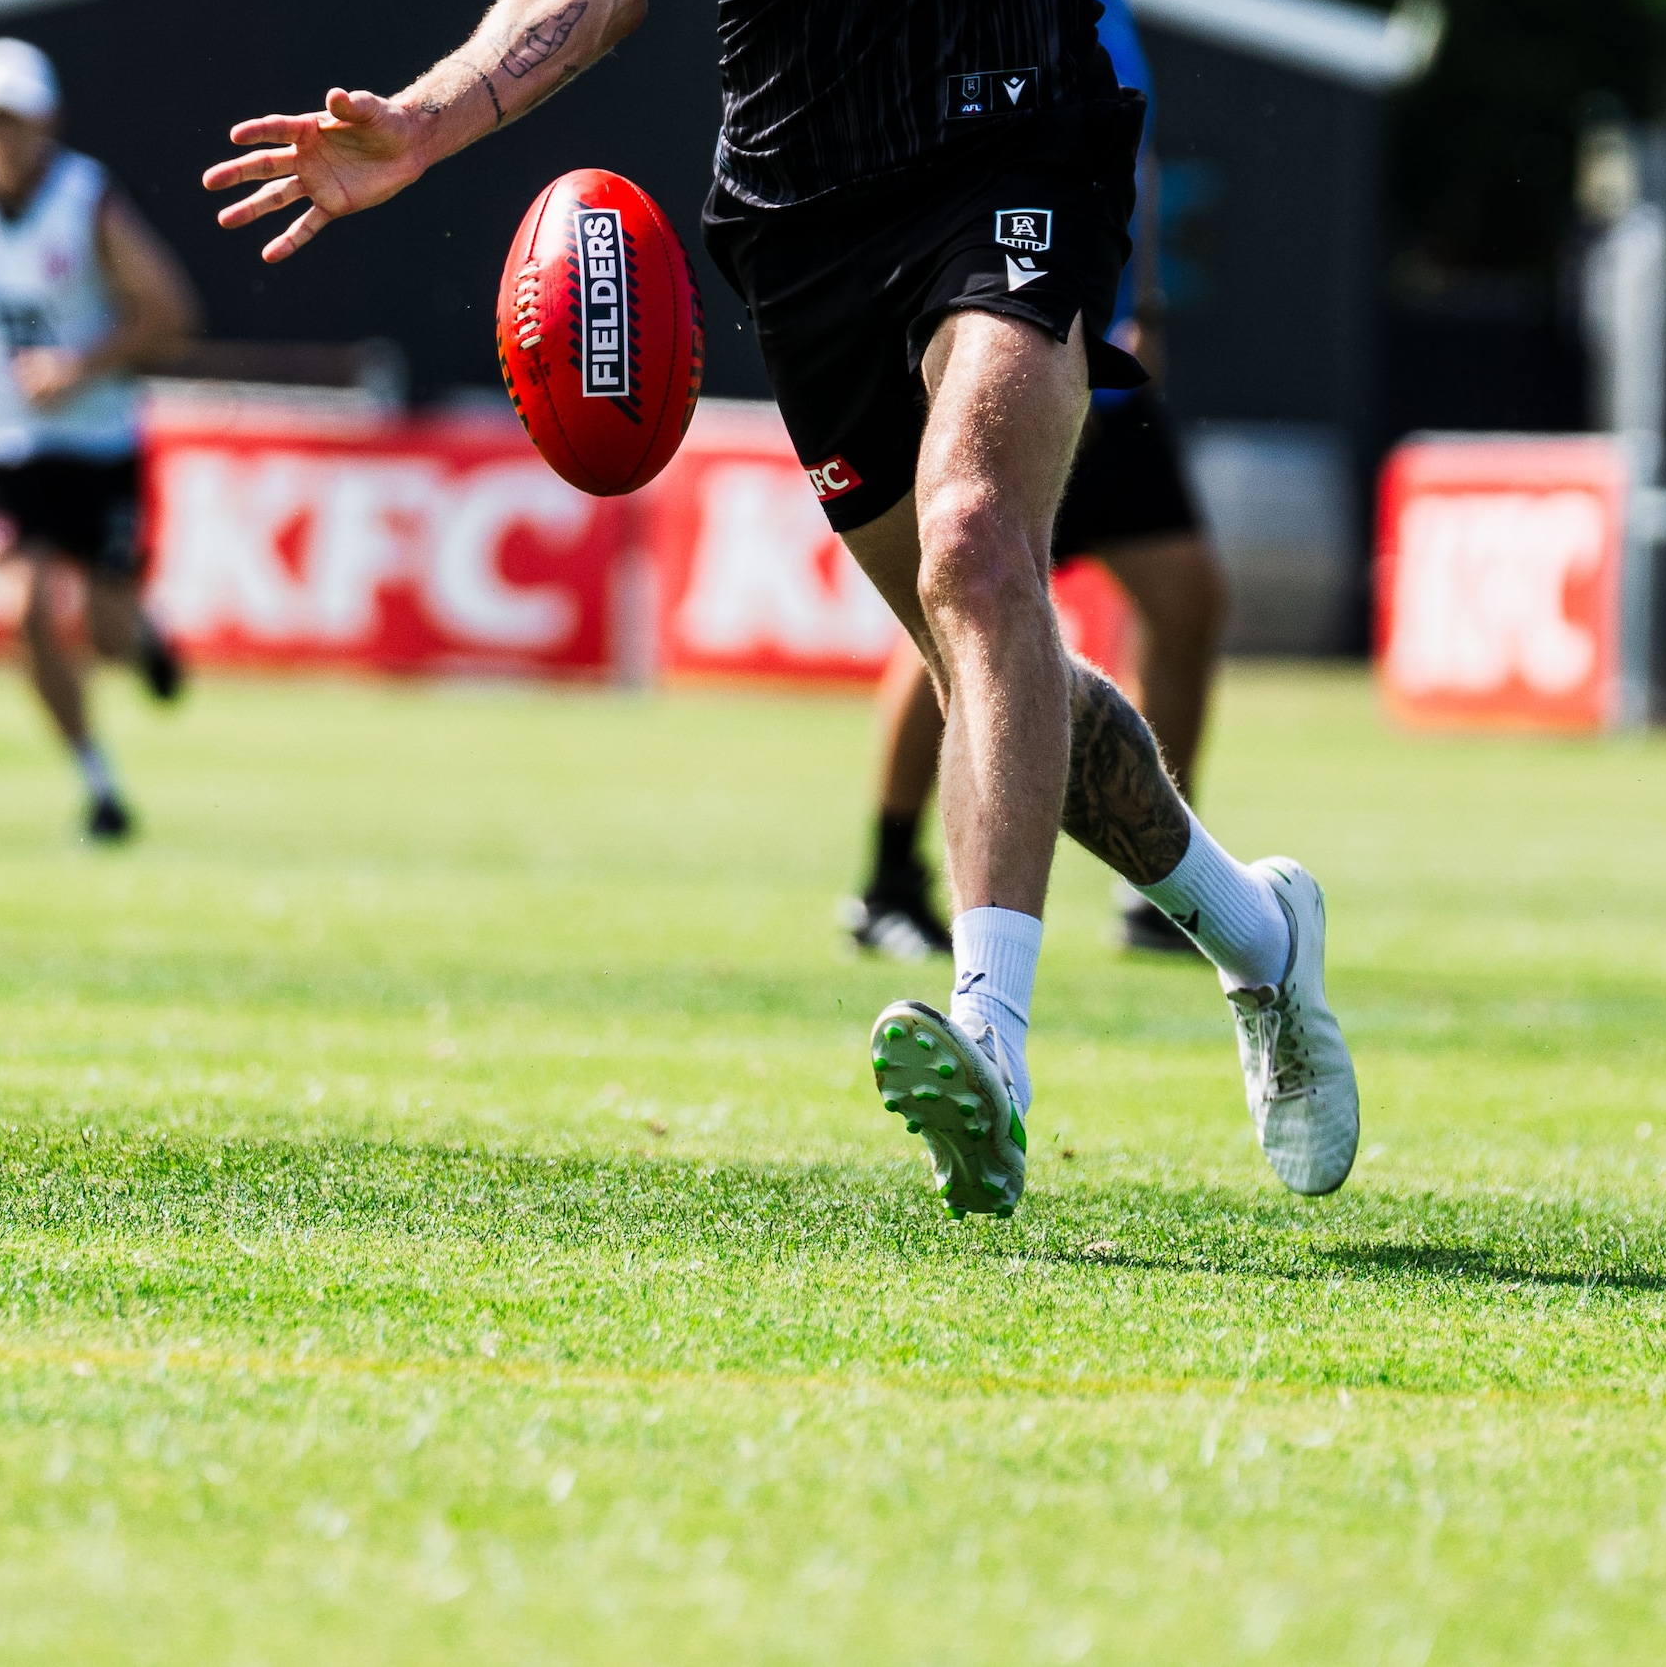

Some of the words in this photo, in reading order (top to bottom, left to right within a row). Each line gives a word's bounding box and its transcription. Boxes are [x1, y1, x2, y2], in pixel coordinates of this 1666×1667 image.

[962, 103, 982, 112] AFL
[583, 215, 620, 387] FIELDERS
[147, 446, 591, 646] KFC
